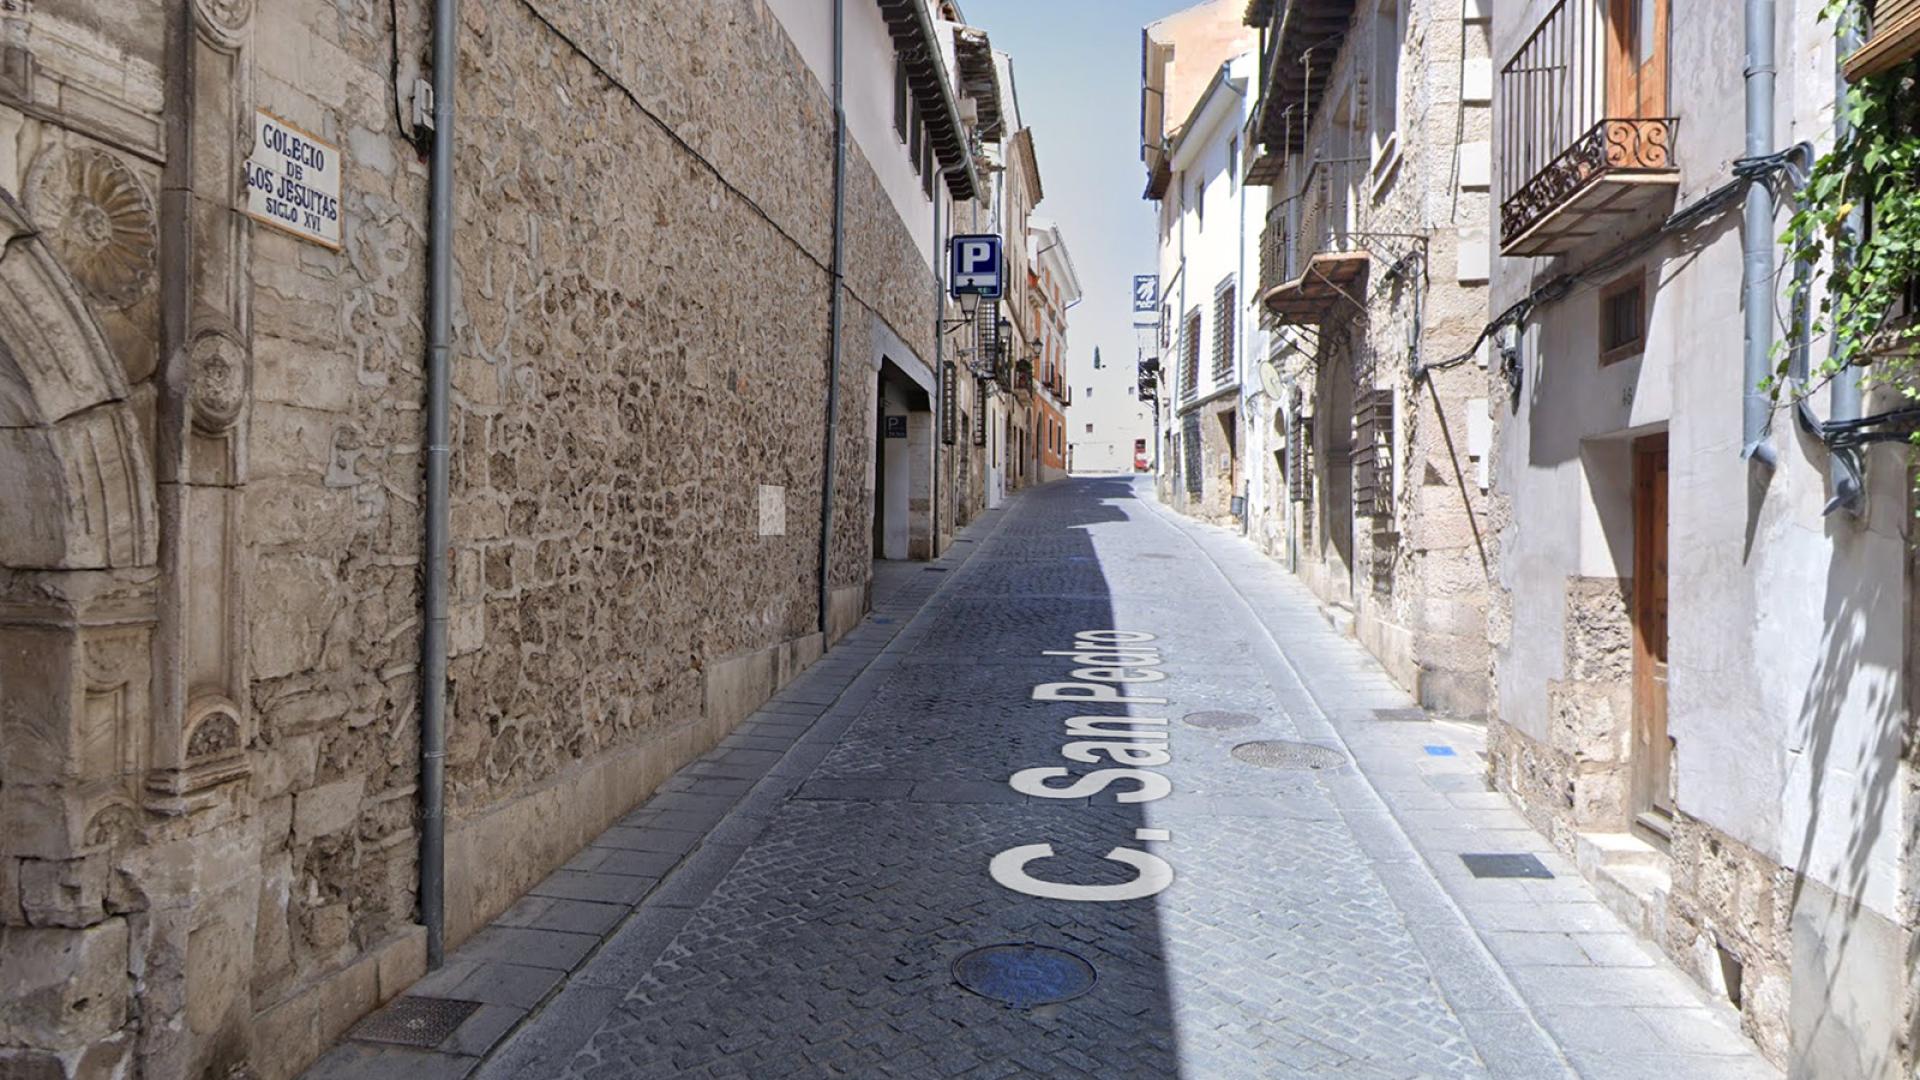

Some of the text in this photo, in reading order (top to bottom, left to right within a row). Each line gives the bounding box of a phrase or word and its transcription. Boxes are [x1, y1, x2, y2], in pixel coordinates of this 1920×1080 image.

[286, 160, 303, 181] DE
[246, 161, 337, 221] LOS JESUITAS
[304, 211, 321, 232] XVI
[963, 243, 990, 273] P
[888, 417, 899, 430] P
